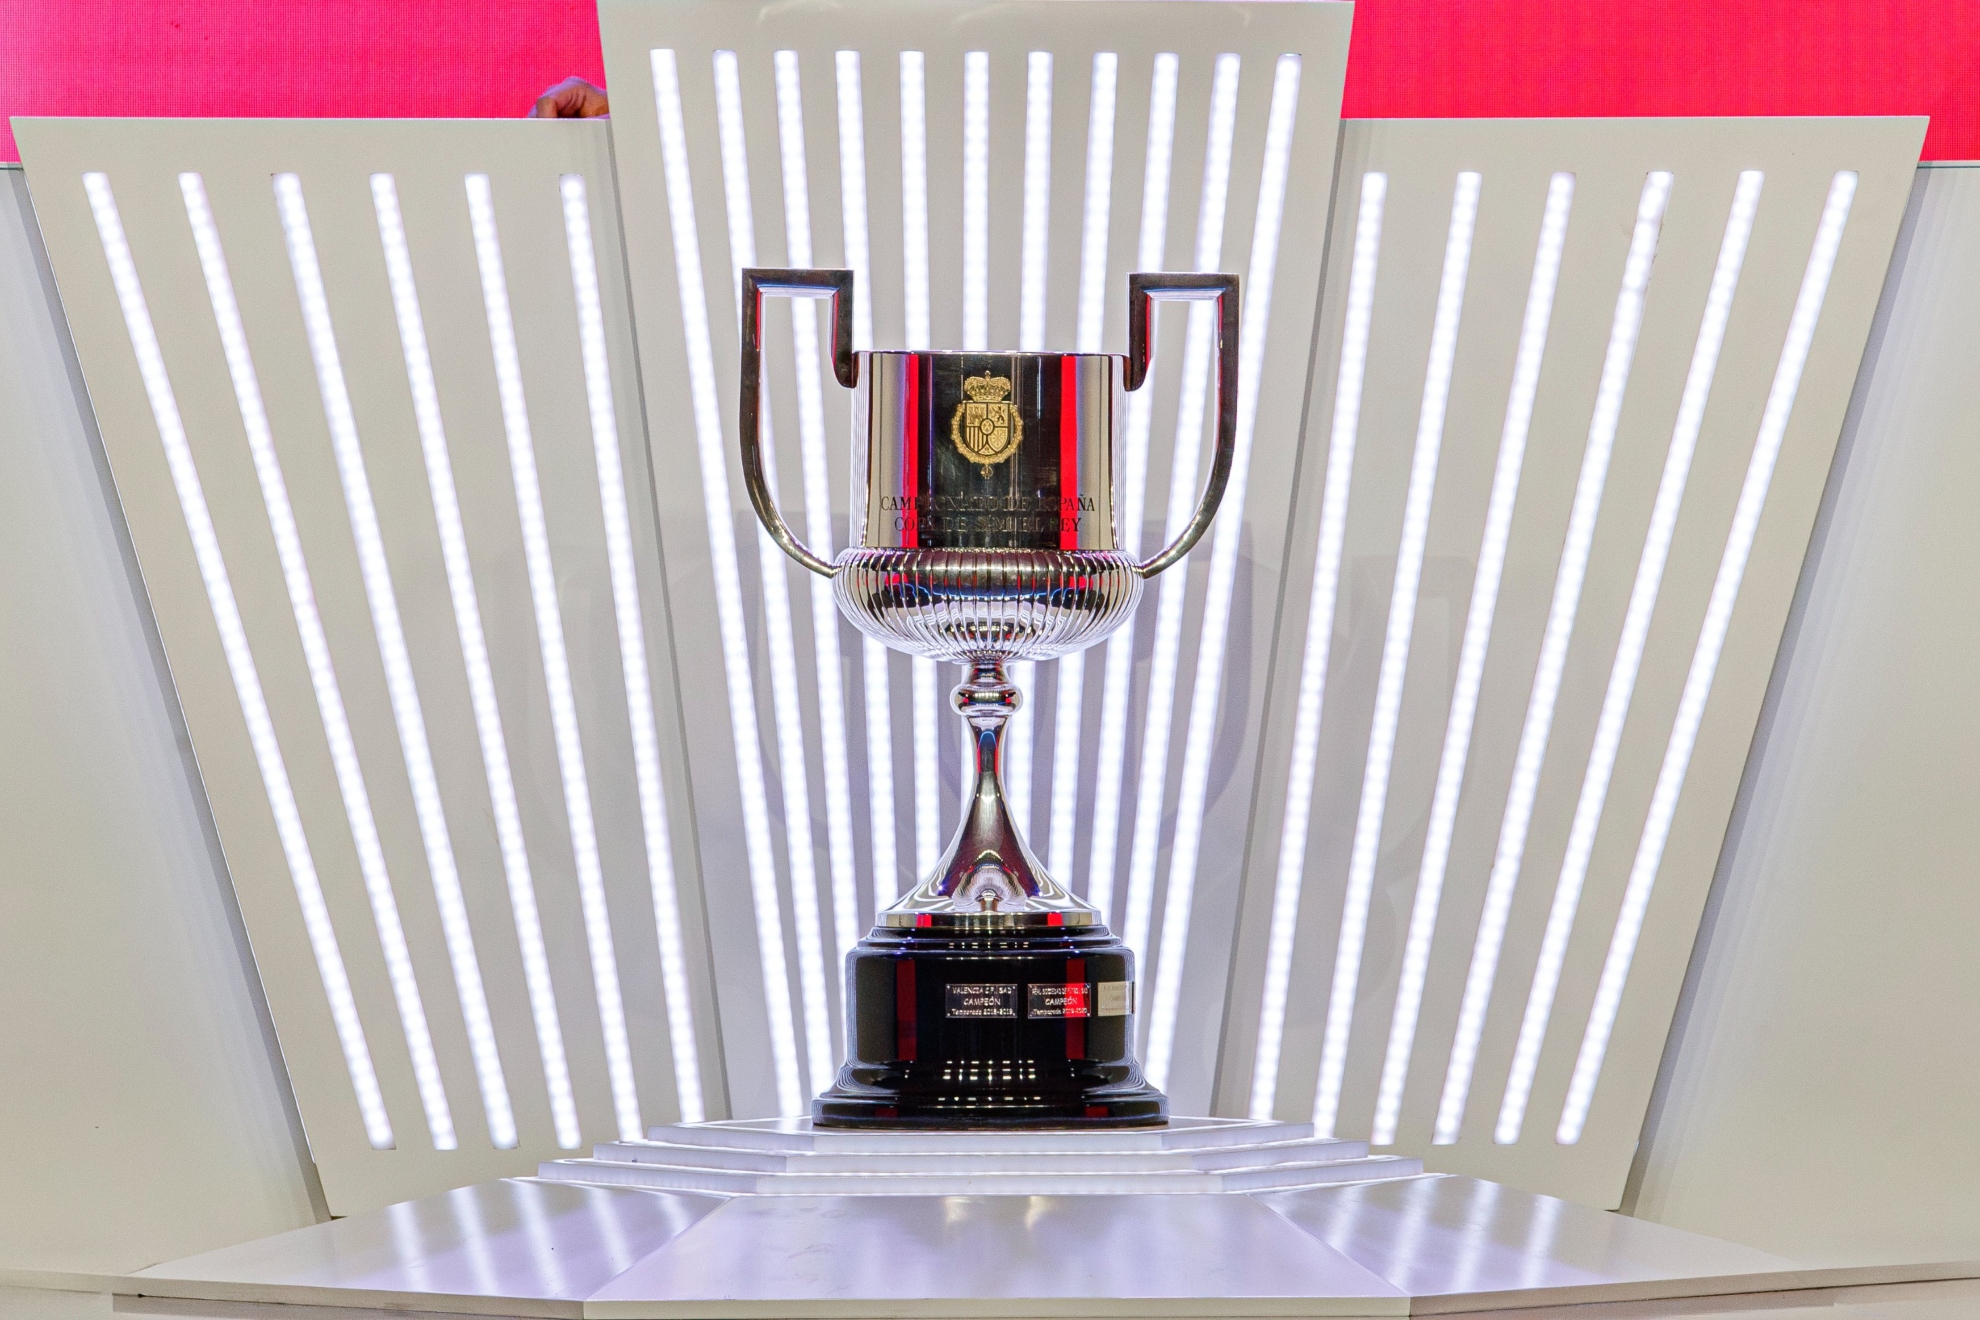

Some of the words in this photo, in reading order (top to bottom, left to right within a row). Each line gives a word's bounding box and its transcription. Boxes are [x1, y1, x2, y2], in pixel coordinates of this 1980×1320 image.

[880, 496, 999, 512] CAMPONATO
[963, 996, 1001, 1006] CAMPEÓN
[1045, 996, 1078, 1006] CAMPEÓN
